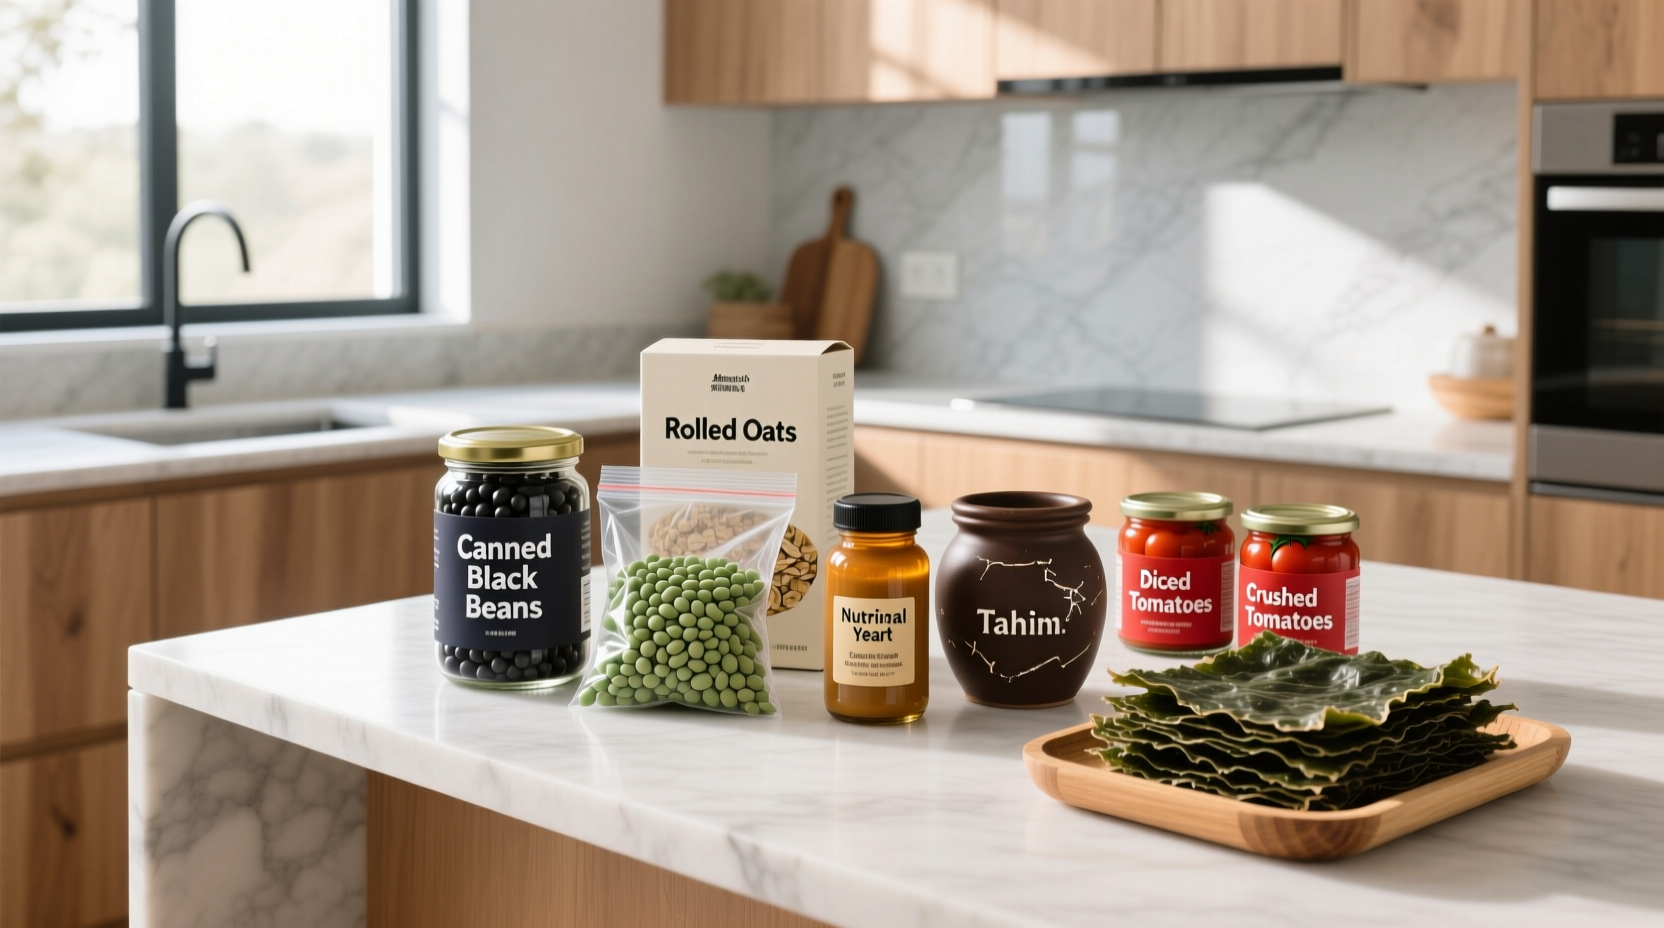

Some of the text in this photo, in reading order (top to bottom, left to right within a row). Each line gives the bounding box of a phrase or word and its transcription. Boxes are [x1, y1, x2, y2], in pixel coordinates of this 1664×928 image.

[665, 417, 797, 443] Rolled Oats
[457, 533, 552, 560] Canned
[467, 564, 538, 590] Black
[1140, 569, 1191, 590] Diced
[466, 594, 543, 619] Beans
[1128, 590, 1213, 614] Tomatoes
[1246, 582, 1318, 607] Crushed
[1245, 605, 1333, 630] Tomatoes
[853, 626, 893, 642] Yeart
